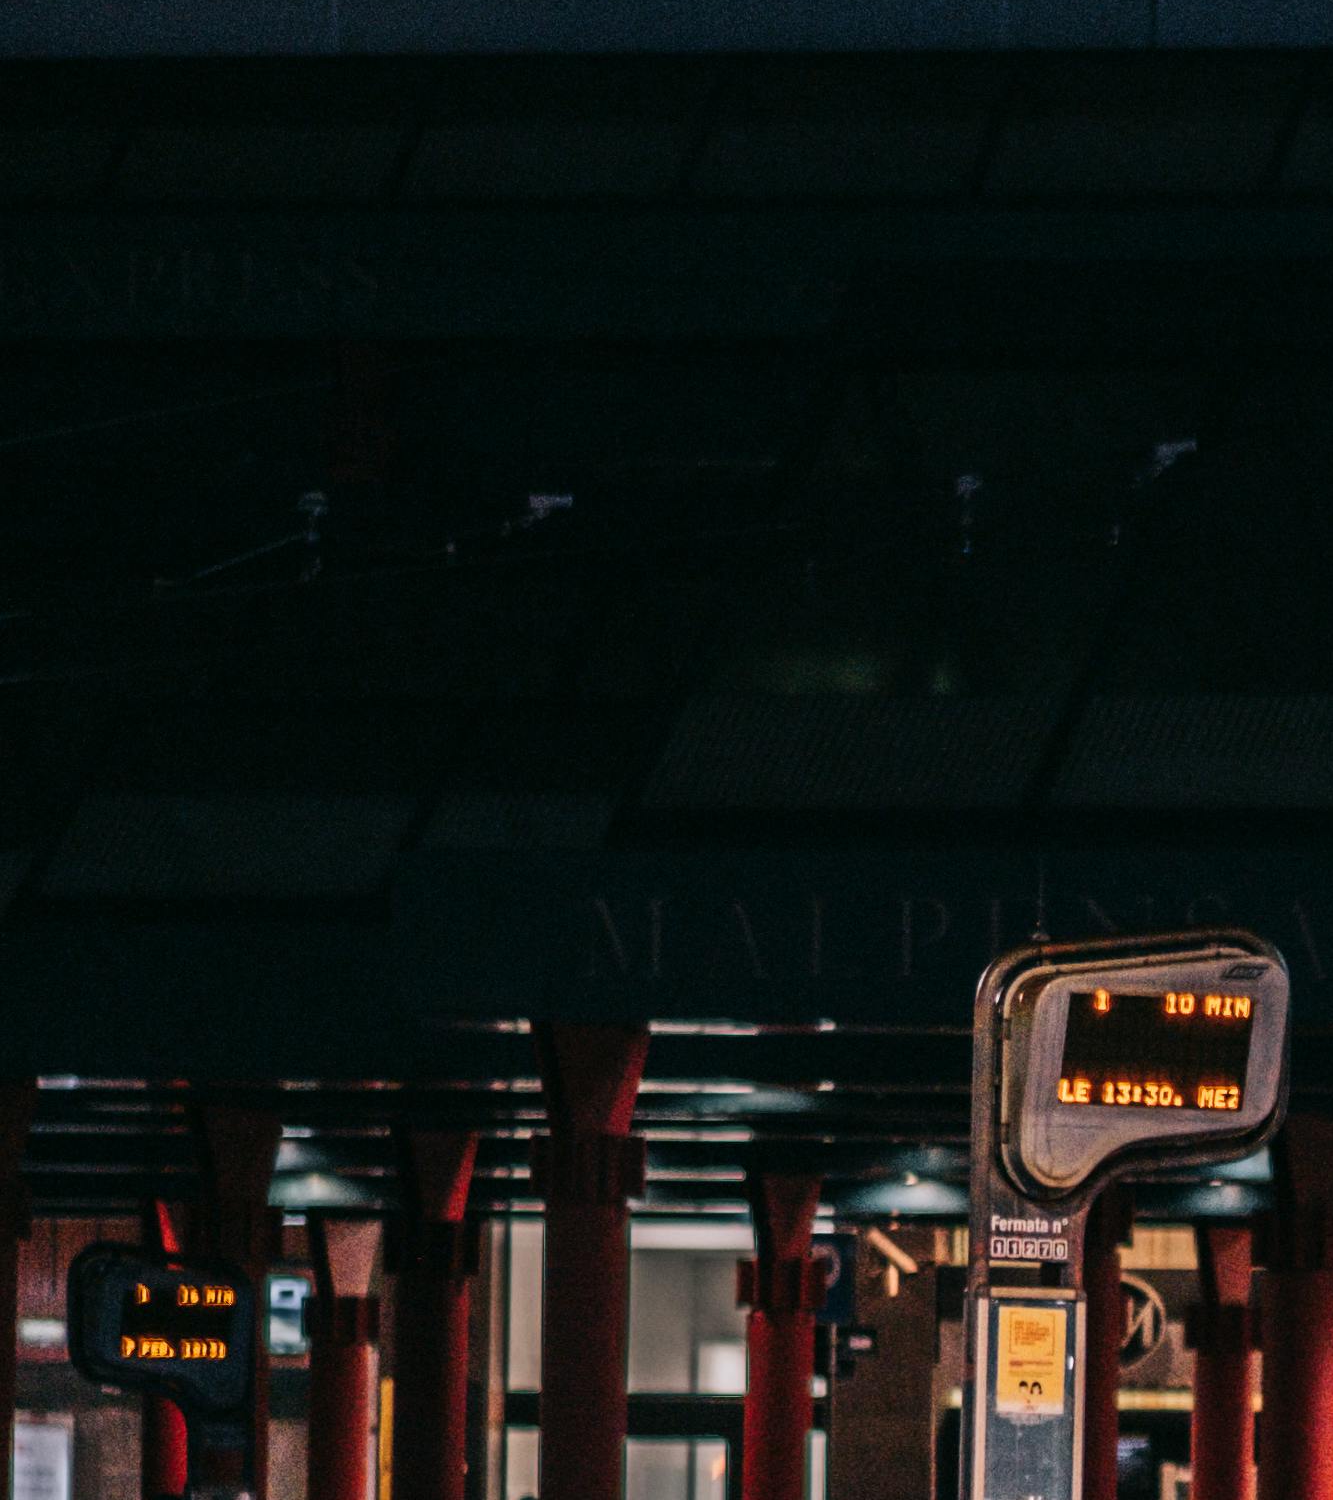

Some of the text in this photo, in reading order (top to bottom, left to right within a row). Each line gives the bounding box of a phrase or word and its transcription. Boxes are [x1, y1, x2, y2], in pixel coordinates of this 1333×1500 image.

[1165, 991, 1195, 1015] 10
[1203, 995, 1250, 1019] MIN
[990, 1214, 1049, 1234] Fermata
[991, 1237, 1067, 1259] 11270
[203, 1285, 236, 1307] MIN
